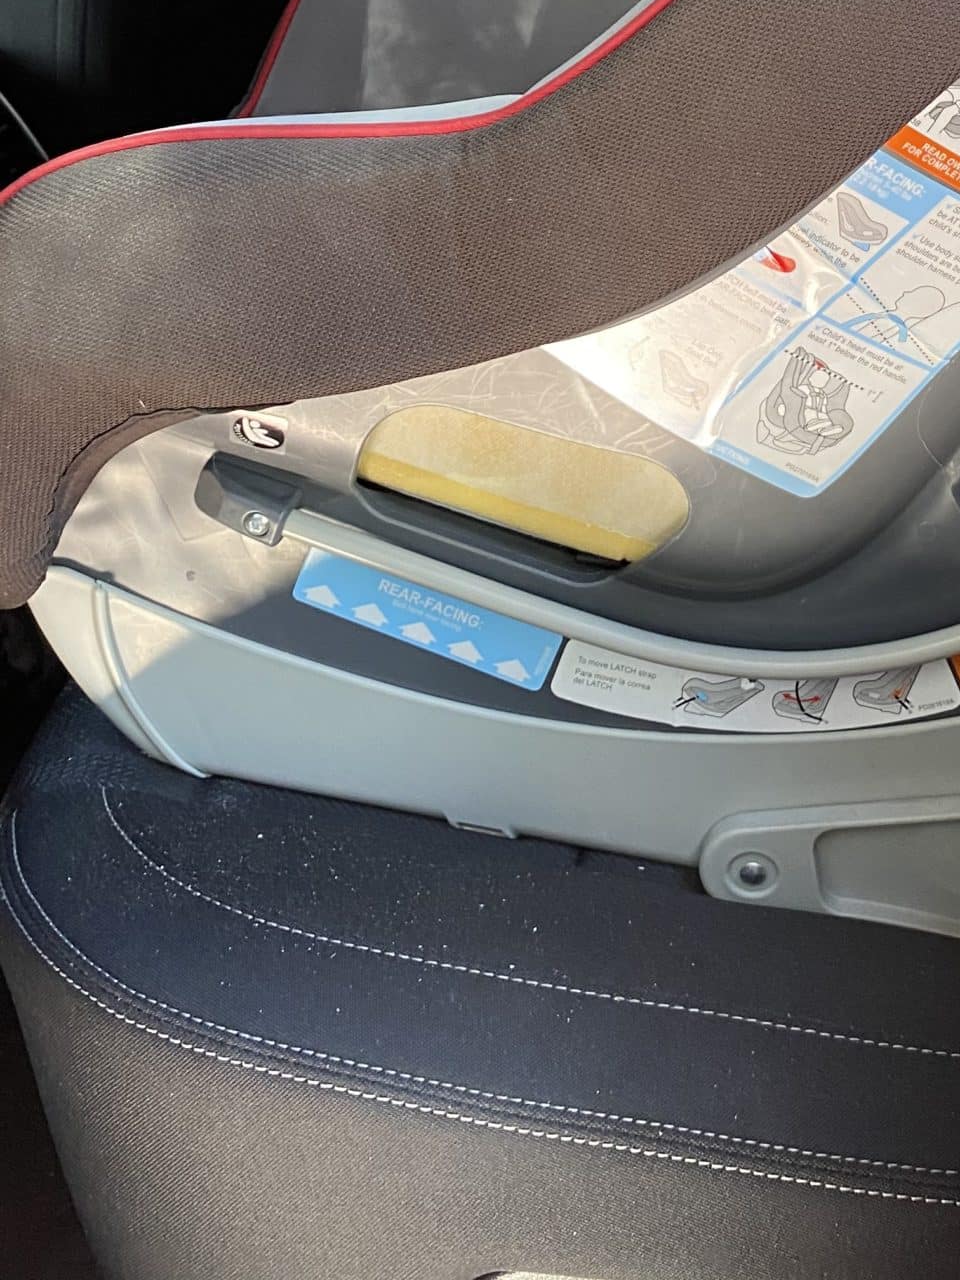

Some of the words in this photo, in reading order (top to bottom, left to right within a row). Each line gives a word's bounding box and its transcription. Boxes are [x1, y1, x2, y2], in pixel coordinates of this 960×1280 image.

[900, 140, 923, 159] FOR
[920, 141, 950, 164] READ
[927, 215, 954, 236] child's
[935, 208, 950, 222] be
[947, 214, 960, 227] AT
[863, 347, 885, 365] must
[882, 356, 896, 369] be
[376, 576, 486, 630] REAR-FACING:
[577, 654, 587, 664] To
[609, 661, 637, 675] LATCH
[585, 677, 613, 691] LATCH
